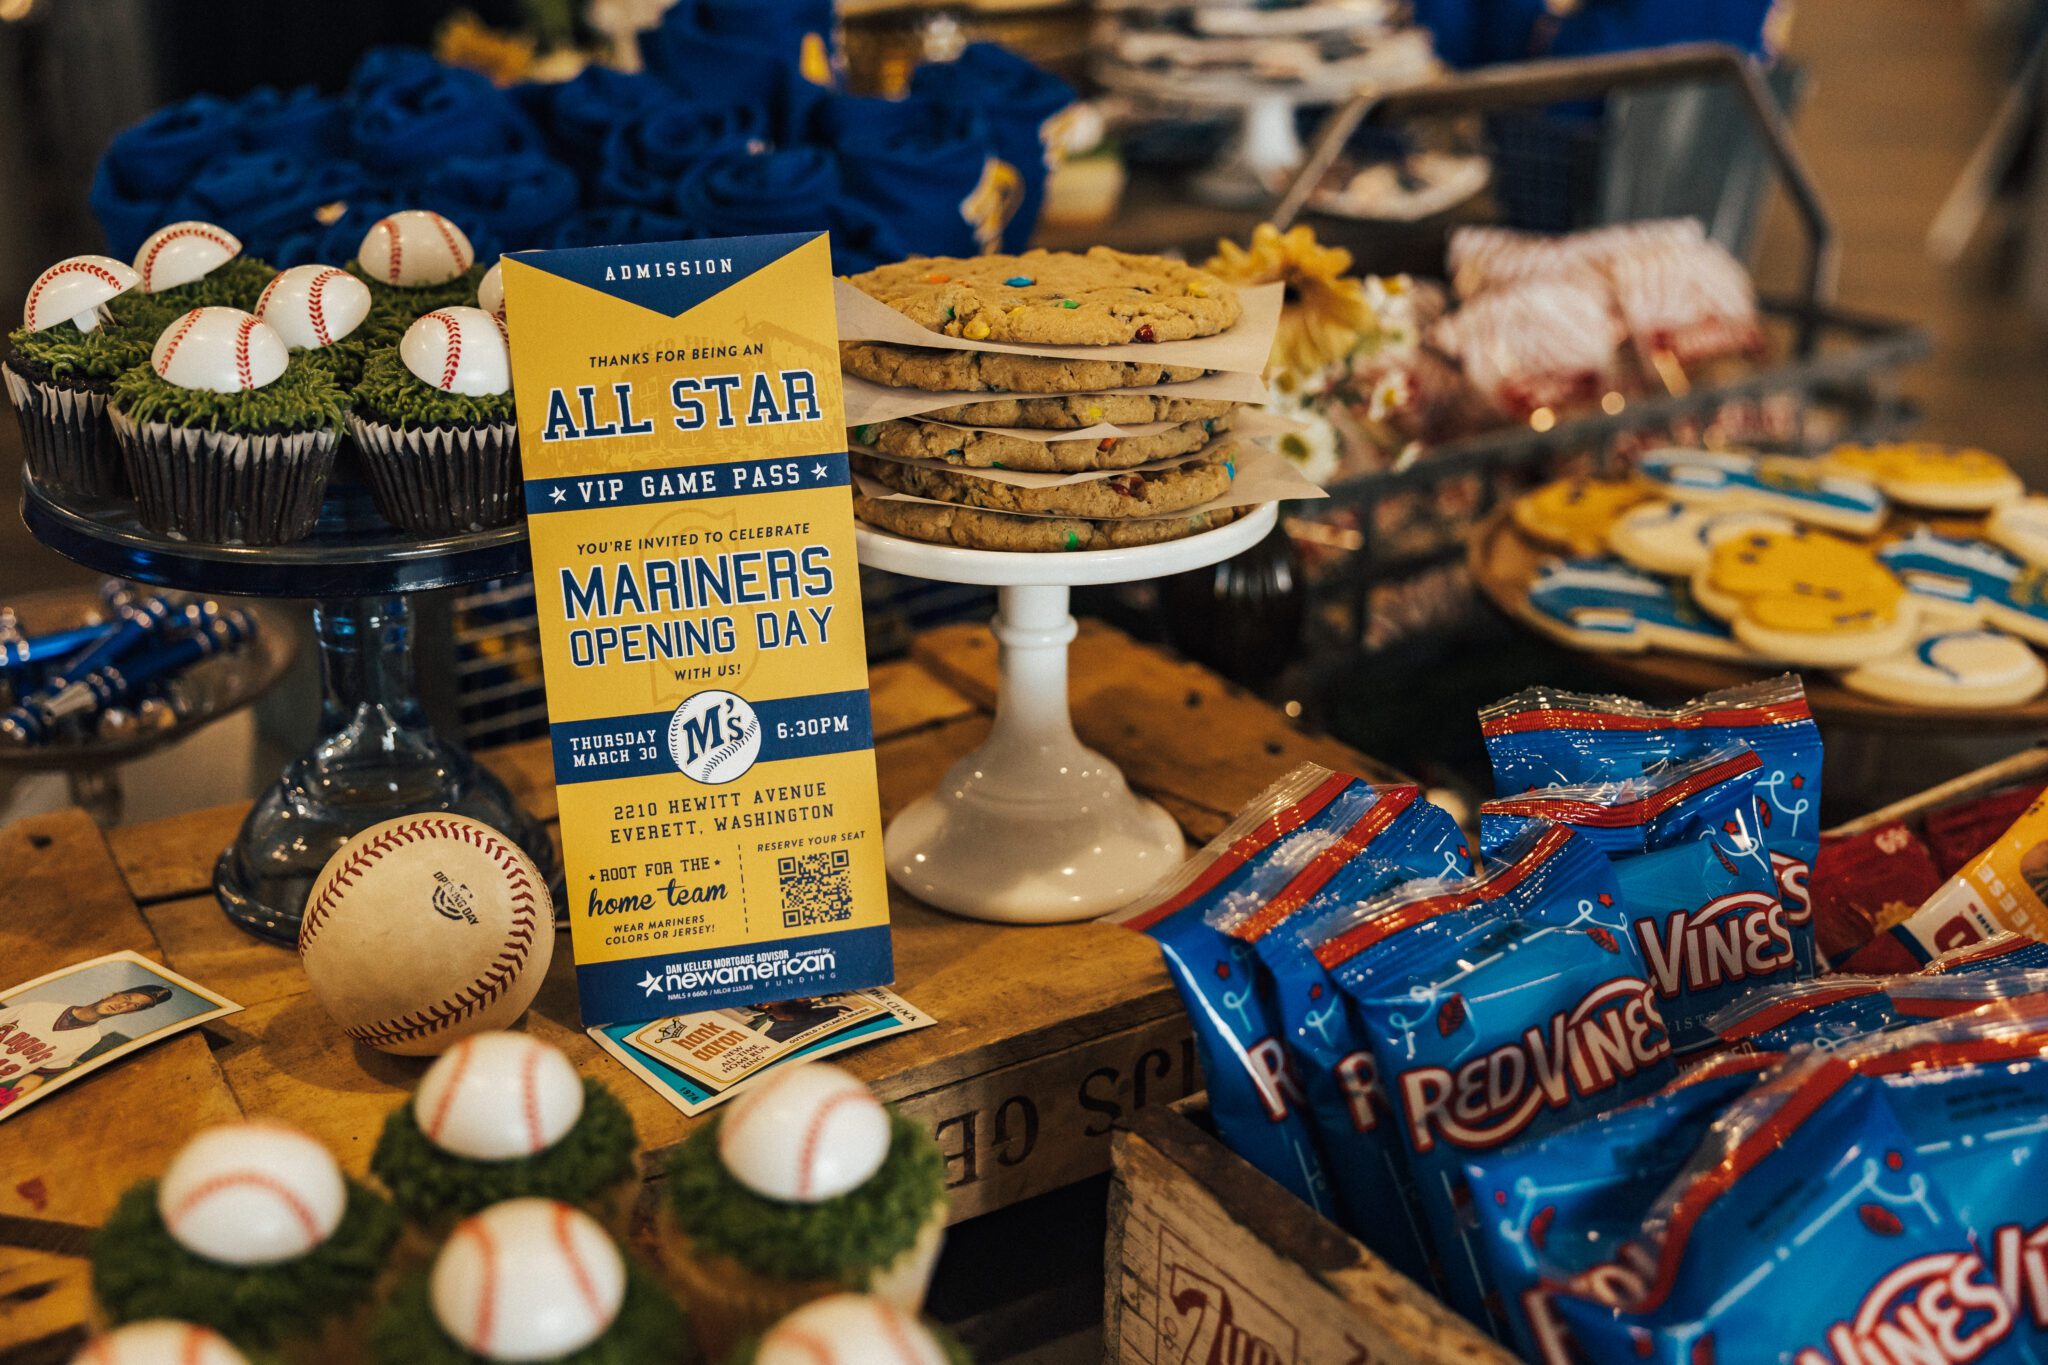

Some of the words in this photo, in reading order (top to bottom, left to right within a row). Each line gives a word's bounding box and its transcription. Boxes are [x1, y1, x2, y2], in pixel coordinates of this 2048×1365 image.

[604, 258, 734, 282] ADMISSION
[589, 352, 650, 368] THANKS
[656, 349, 686, 363] FOR
[692, 345, 738, 360] BEING
[743, 343, 764, 356] AN
[542, 381, 655, 443] ALL
[670, 368, 822, 433] STAR
[578, 479, 624, 504] VIP
[641, 470, 717, 499] GAME
[733, 463, 801, 491] PASS
[577, 539, 633, 556] YOU'RE
[638, 533, 699, 551] INVITED
[704, 530, 724, 544] TO
[729, 522, 811, 542] CELEBRATE
[559, 544, 835, 622] MARINERS
[568, 615, 737, 669] OPENING
[756, 604, 836, 651] DAY
[674, 666, 712, 682] WITH
[717, 663, 742, 678] US!
[570, 729, 658, 751] THURSDAY
[776, 715, 850, 740] 6:30PM
[573, 750, 630, 768] MARCH
[639, 746, 658, 762] 30
[614, 803, 658, 821] 2210
[668, 792, 741, 815] HEWITT
[753, 782, 827, 804] AVENUE
[610, 820, 704, 844] EVERETT,
[714, 803, 835, 832] WASHINGTON
[757, 838, 804, 852] RESERVE
[808, 834, 838, 846] YOUR
[841, 830, 866, 842] SEAT
[600, 865, 637, 882] ROOT
[645, 861, 674, 877] FOR
[680, 857, 711, 872] THE
[433, 871, 468, 908] OPING
[462, 907, 480, 925] DAY
[588, 887, 657, 918] home
[656, 878, 729, 907] team
[605, 932, 650, 946] COLORS
[653, 930, 669, 940] OR
[672, 924, 716, 938] JERSEY!
[613, 922, 644, 934] WEAR
[648, 915, 706, 930] MARINERS
[1635, 890, 1795, 998] VINES
[665, 963, 683, 975] DAN
[683, 960, 713, 973] KELLER
[713, 953, 755, 969] MORTGAGE
[756, 949, 790, 963] ADVISOR
[665, 953, 836, 992] newamerican
[765, 972, 837, 988] FUNDING
[667, 992, 687, 1001] NMLS
[886, 1000, 920, 1022] CLOCK
[671, 1021, 727, 1051] hank
[692, 1030, 749, 1062] aaron
[721, 1043, 760, 1068] ALL-TIME
[721, 1055, 751, 1074] HOME
[750, 1044, 771, 1058] RUN
[723, 1045, 744, 1060] NEW
[740, 1055, 766, 1070] KING
